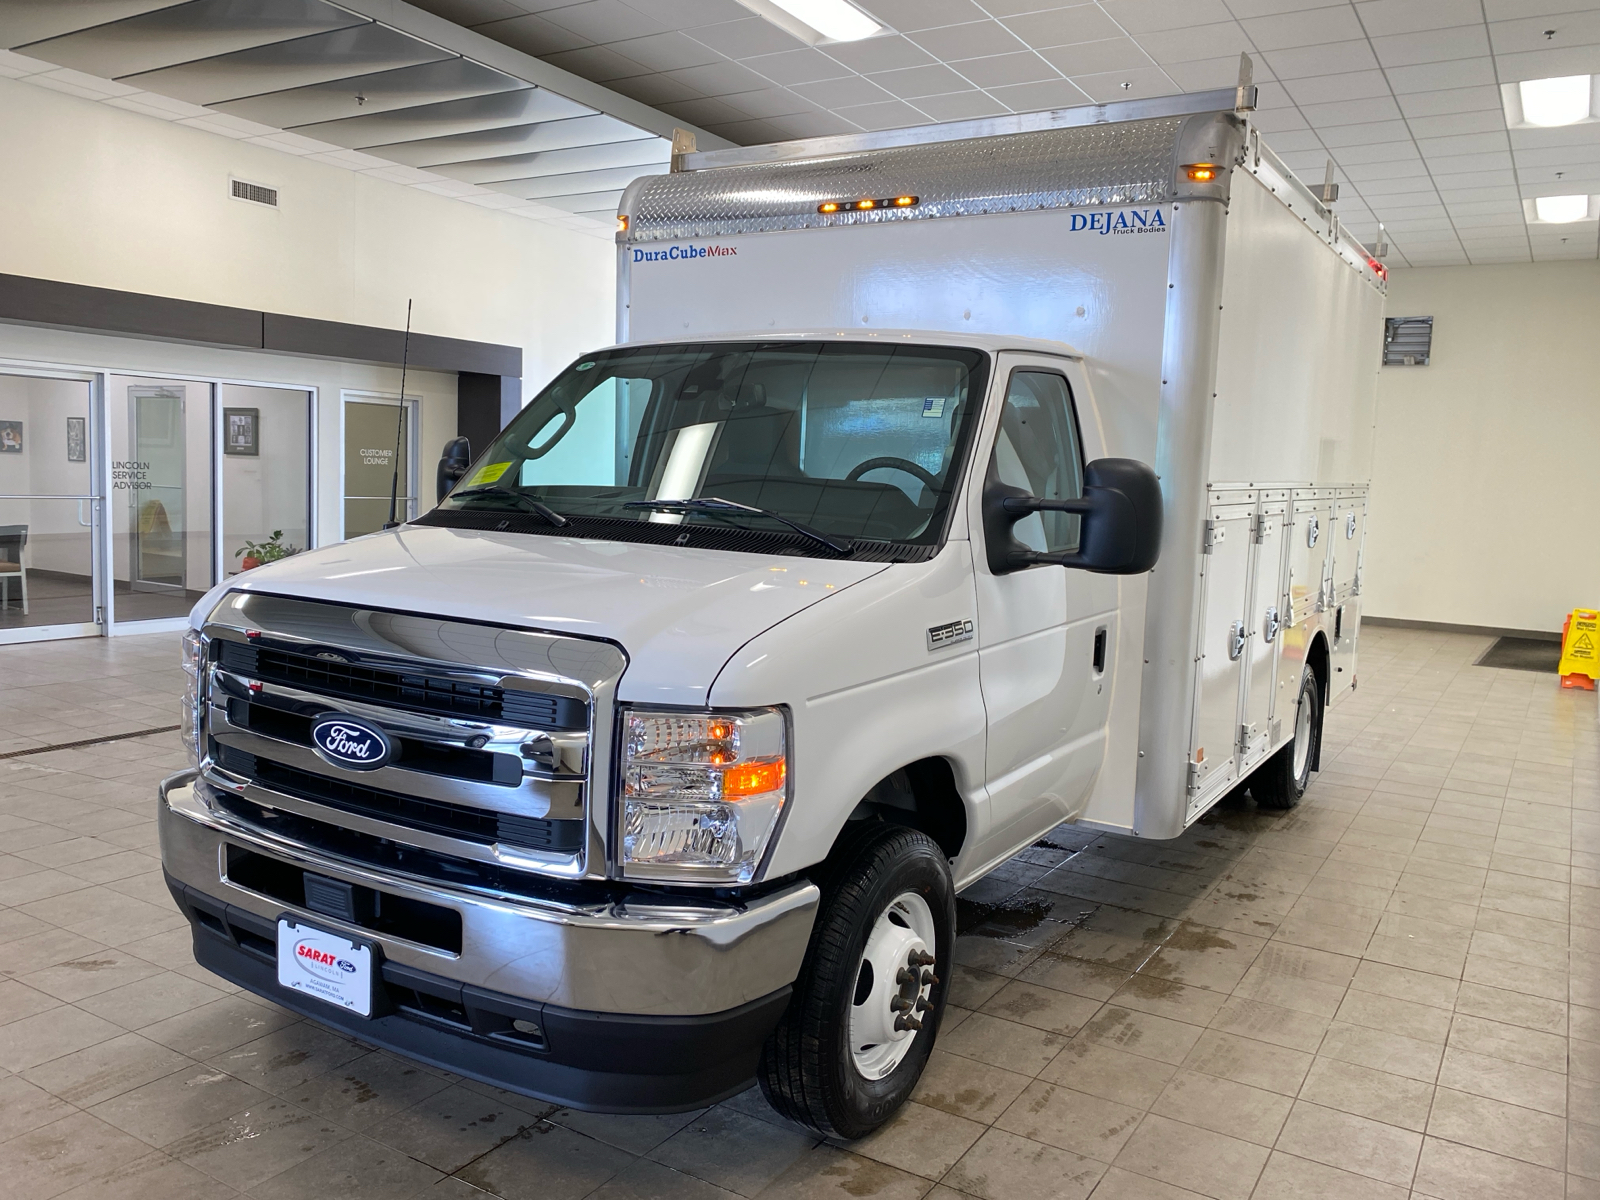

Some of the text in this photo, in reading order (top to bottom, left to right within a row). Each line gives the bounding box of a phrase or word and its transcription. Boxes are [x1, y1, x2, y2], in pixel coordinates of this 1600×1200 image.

[1070, 209, 1166, 235] DEJANA
[633, 245, 737, 262] DuraCubeMax
[360, 449, 392, 457] CUSTOMER
[112, 461, 150, 470] LINCOLN
[112, 471, 147, 480] SERVICE
[113, 481, 152, 490] ADVISOR
[326, 725, 371, 758] Ford
[297, 945, 336, 966] SARAT
